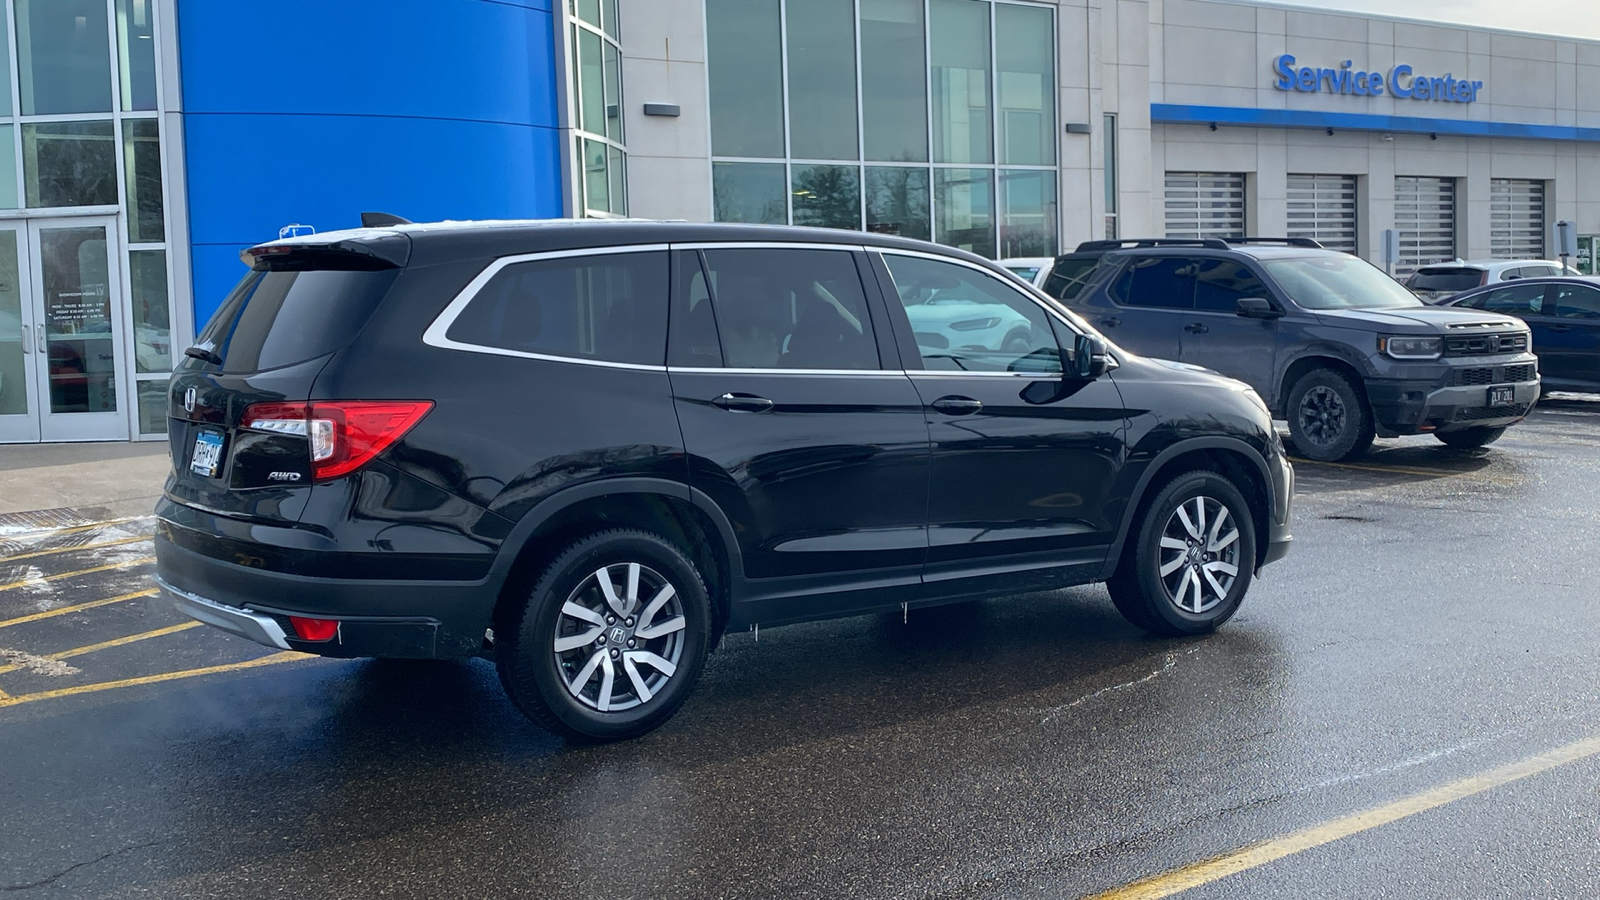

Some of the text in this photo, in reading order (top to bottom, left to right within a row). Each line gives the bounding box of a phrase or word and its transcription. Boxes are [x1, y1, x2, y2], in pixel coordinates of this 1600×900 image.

[1273, 53, 1483, 103] Service Center
[267, 471, 301, 481] AWD
